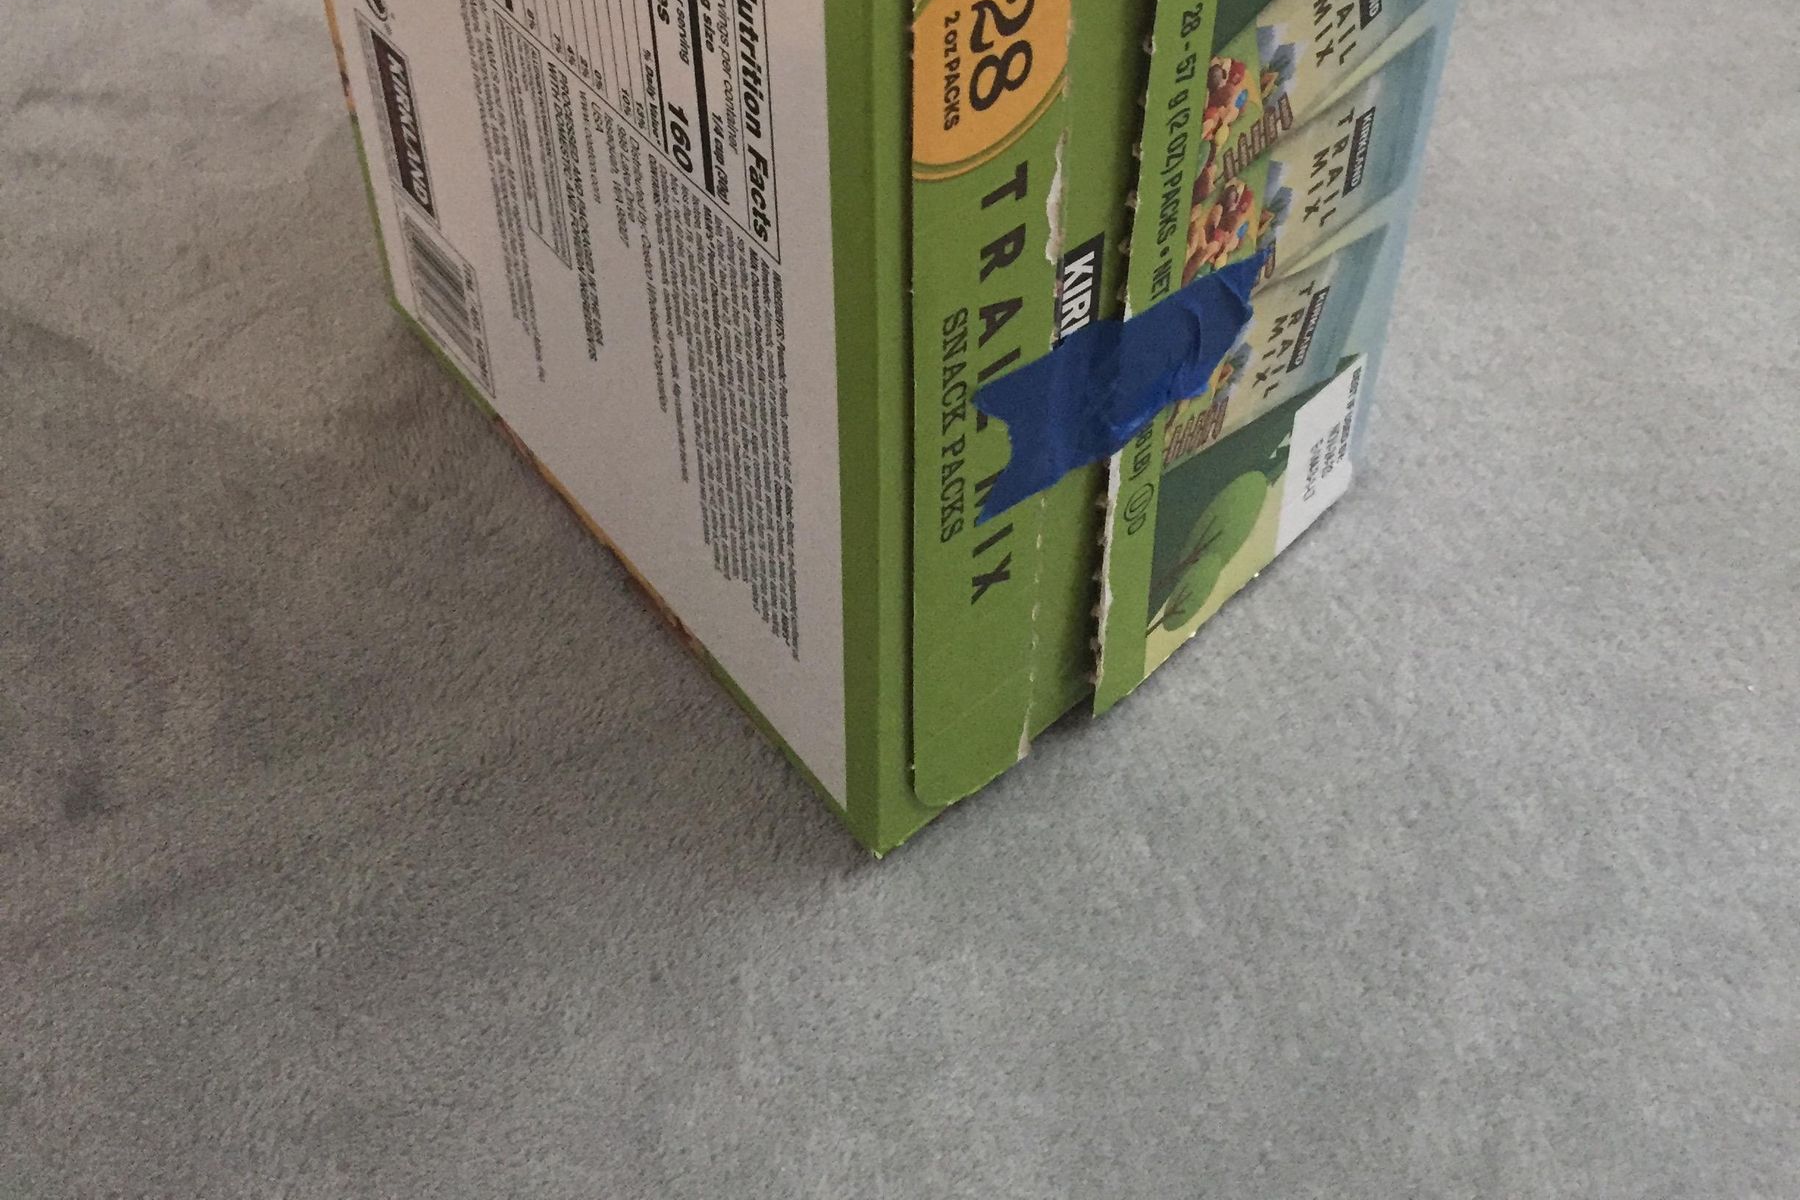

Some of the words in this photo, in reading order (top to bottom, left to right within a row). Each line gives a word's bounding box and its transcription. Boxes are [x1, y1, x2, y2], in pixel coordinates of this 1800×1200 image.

[674, 4, 691, 68] serving
[702, 10, 715, 56] size
[943, 10, 961, 27] 2
[1180, 2, 1203, 38] 28
[547, 58, 562, 104] WITH
[643, 61, 656, 103] Daily
[719, 45, 732, 81] per
[943, 55, 961, 132] PACKS
[1175, 52, 1197, 84] 57
[384, 48, 431, 211] KIRKLAND
[557, 68, 579, 166] PROCESSED
[570, 160, 584, 199] AND
[590, 98, 604, 137] USA
[666, 95, 693, 178] 160
[710, 107, 724, 139] 1/4
[712, 134, 725, 168] cup
[723, 77, 739, 156] container
[1350, 111, 1374, 188] KIRKLAND
[628, 133, 646, 213] Distributed
[714, 162, 729, 208] (30g)
[746, 141, 772, 249] Facts
[1302, 146, 1331, 223] MIX
[1319, 106, 1356, 228] TRAIL
[1157, 169, 1184, 244] PACKS
[1151, 257, 1173, 301] NET
[941, 306, 969, 438] SNACK
[1251, 314, 1289, 390] MIX
[1262, 279, 1317, 399] TRAIL
[940, 434, 967, 544] PACKS
